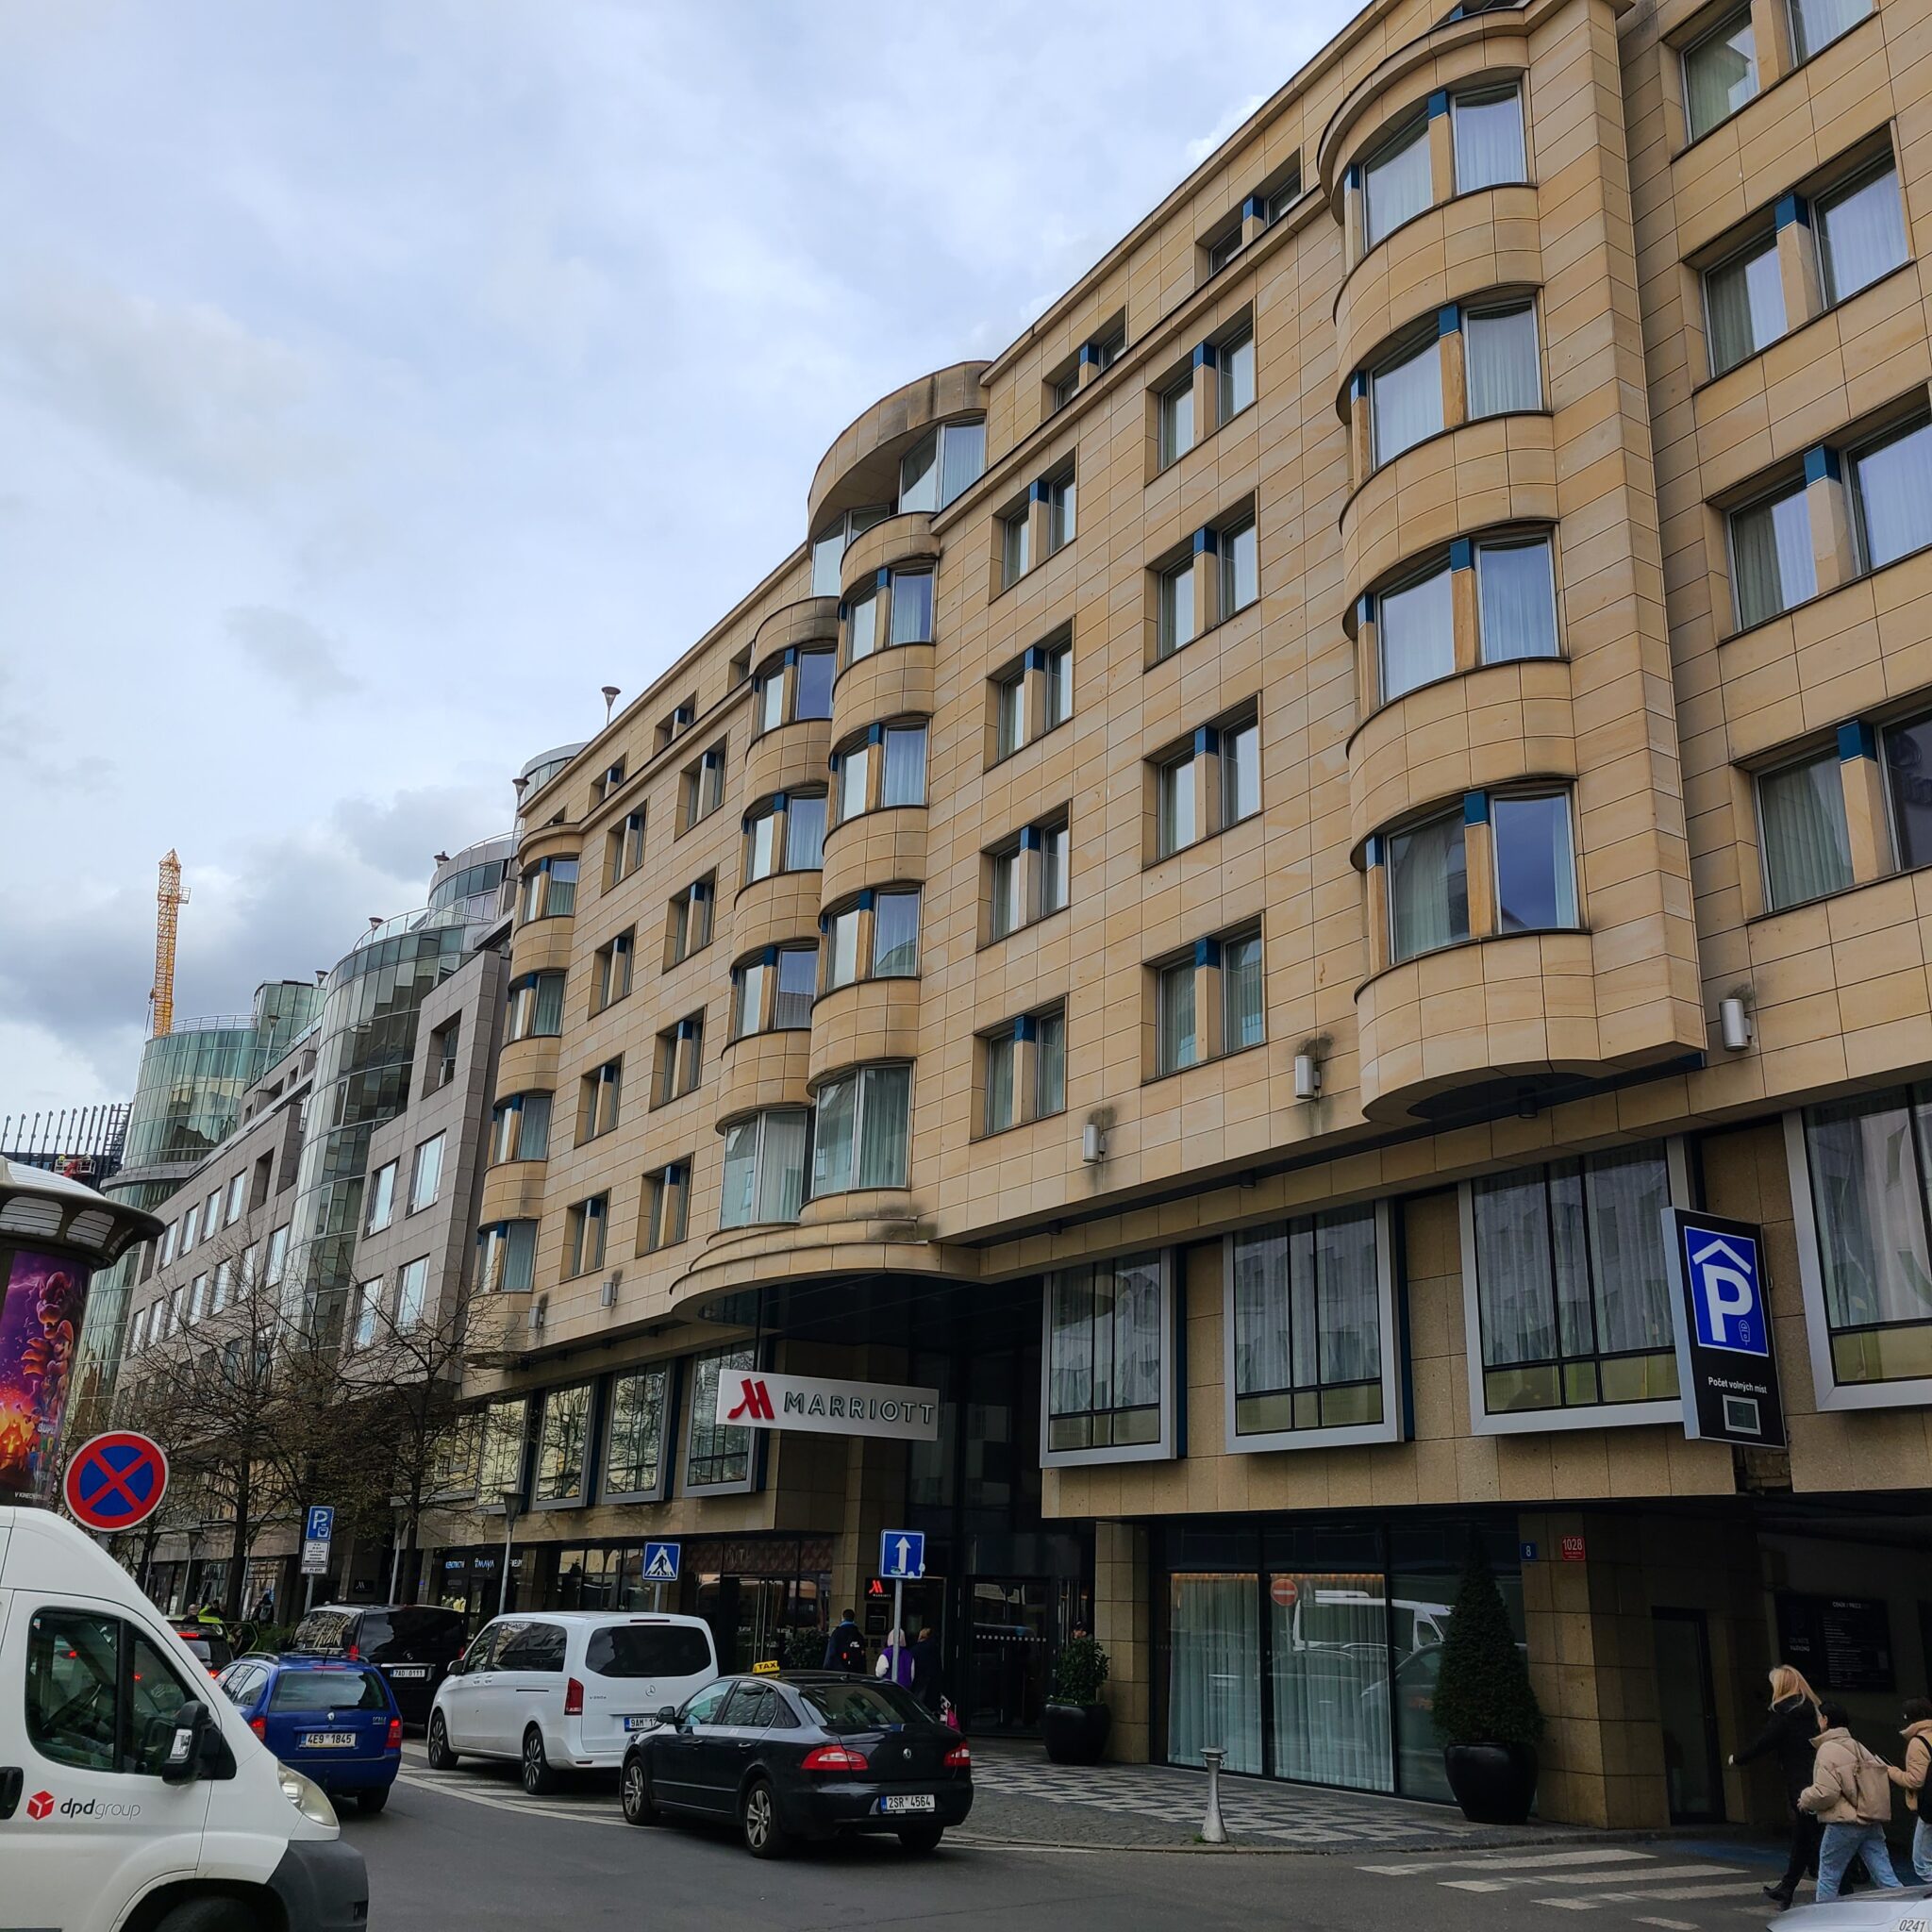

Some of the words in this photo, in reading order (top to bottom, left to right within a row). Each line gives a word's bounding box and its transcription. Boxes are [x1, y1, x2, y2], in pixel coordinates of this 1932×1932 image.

[1702, 1263, 1753, 1342] P
[1707, 1375, 1728, 1388] Počet
[1728, 1380, 1754, 1392] volných
[1754, 1384, 1768, 1394] míst
[784, 1391, 934, 1424] MARRIOTT
[312, 1509, 328, 1530] P
[1525, 1545, 1532, 1557] 8
[1562, 1538, 1583, 1551] 1028
[308, 1734, 324, 1744] 4E9
[331, 1734, 352, 1744] 1845
[59, 1798, 141, 1821] dpdgroup
[889, 1797, 905, 1808] 2SR
[910, 1796, 931, 1807] 4564
[1899, 1919, 1926, 1932] 0241
